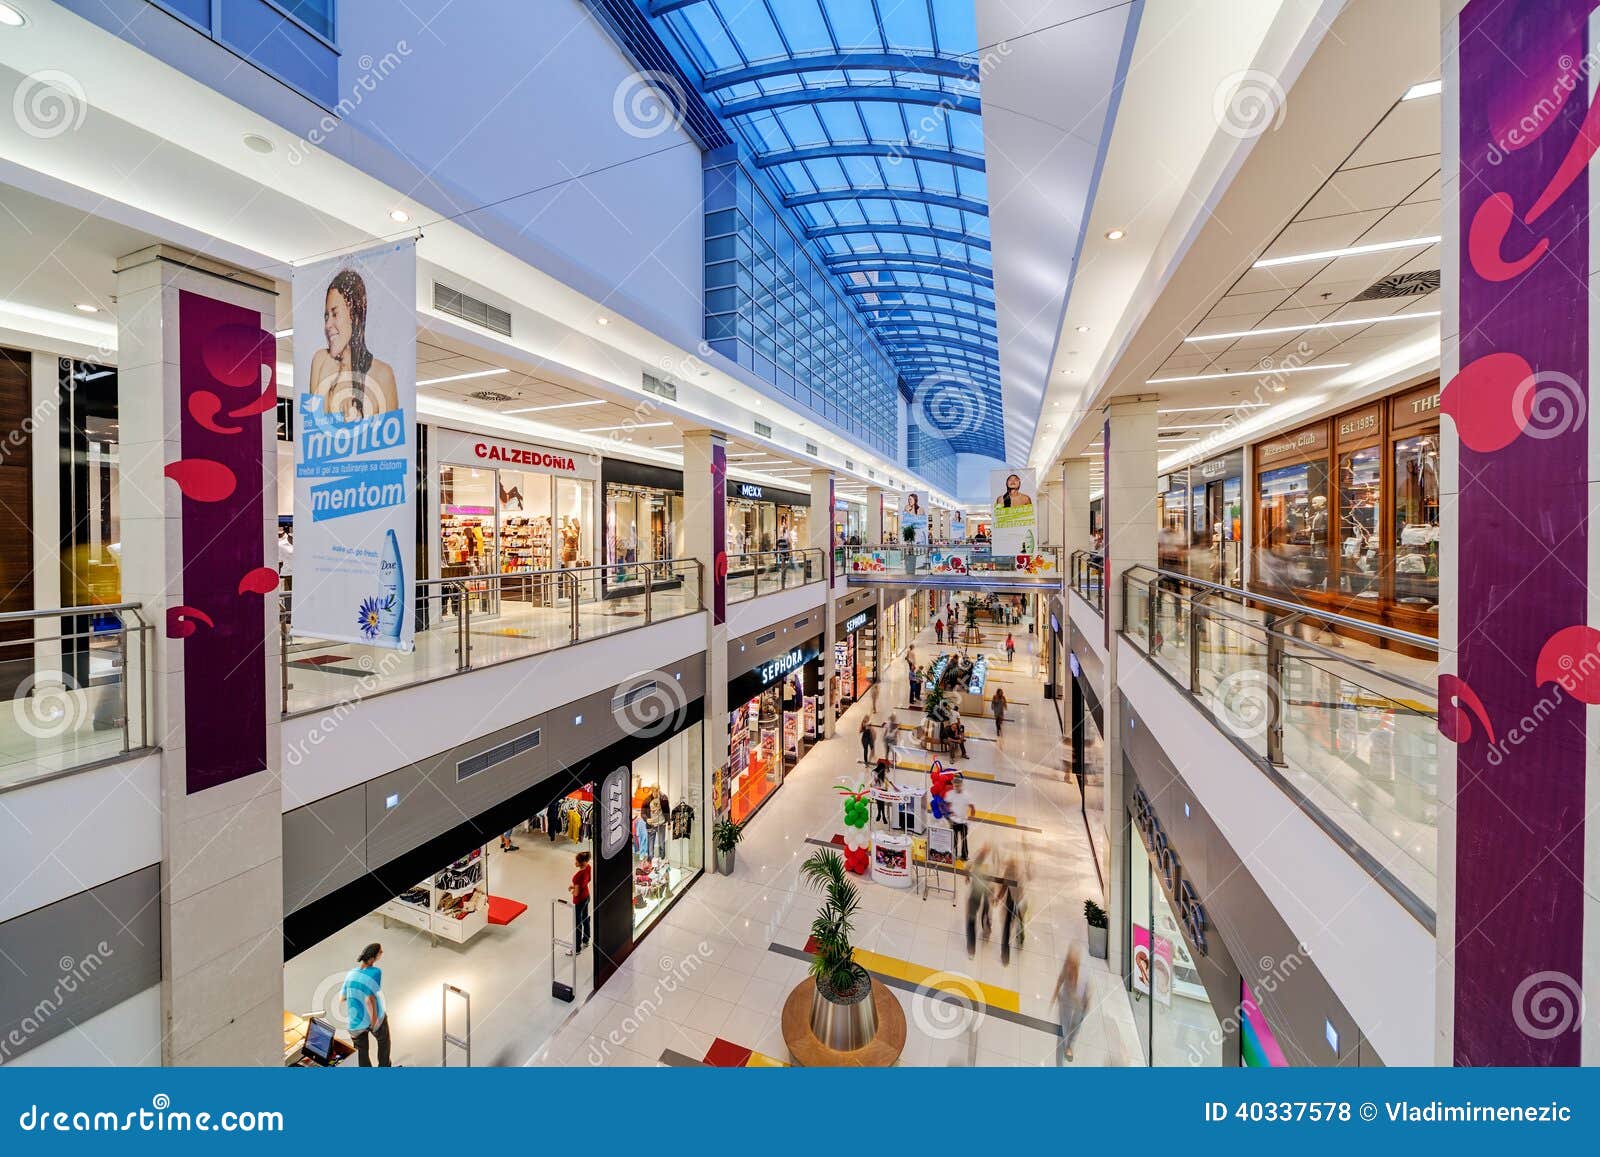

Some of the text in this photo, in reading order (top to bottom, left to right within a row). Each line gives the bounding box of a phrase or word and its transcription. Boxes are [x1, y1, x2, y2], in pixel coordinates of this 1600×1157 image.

[1411, 393, 1440, 414] THE
[1357, 415, 1375, 431] 1985
[307, 416, 401, 460] mojito
[1297, 433, 1316, 447] Club
[474, 443, 576, 471] CALZEDONIA
[311, 480, 404, 511] mentom
[845, 612, 867, 633] SEPHORA
[762, 649, 803, 685] SEPHORA
